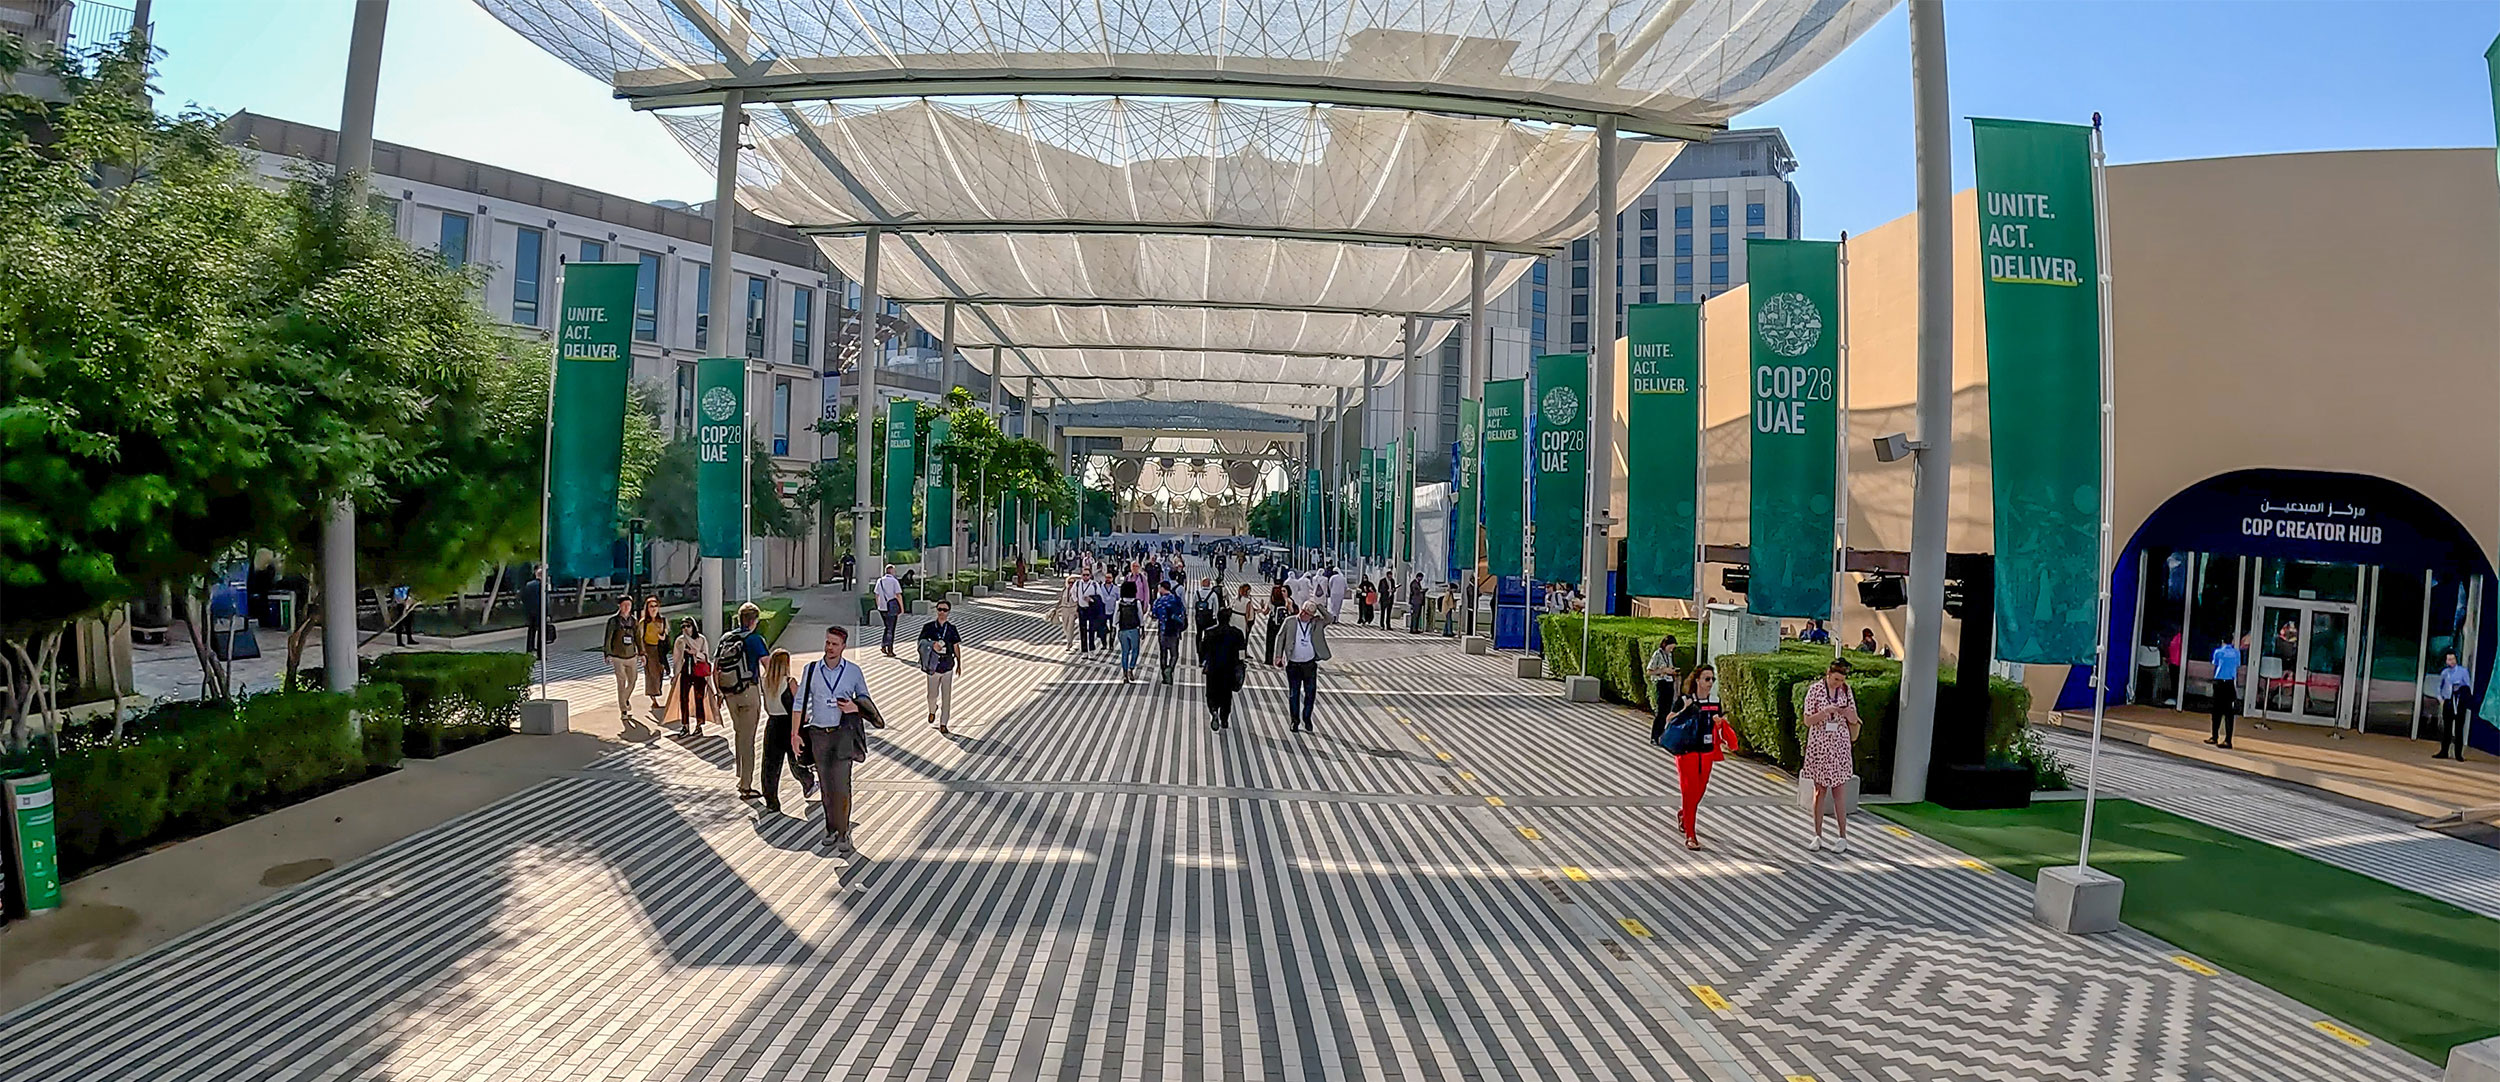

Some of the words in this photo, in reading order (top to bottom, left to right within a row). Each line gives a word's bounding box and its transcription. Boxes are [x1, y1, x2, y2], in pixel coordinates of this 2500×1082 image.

[1987, 191, 2056, 219] UNITE.
[1988, 223, 2034, 249] ACT.
[1990, 254, 2085, 284] DELIVER.
[567, 307, 608, 322] UNITE.
[564, 325, 592, 340] ACT.
[564, 343, 620, 359] DELIVER.
[1633, 343, 1674, 358] UNITE.
[1633, 361, 1660, 375] ACT.
[1633, 378, 1689, 393] DELIVER.
[1756, 365, 1833, 401] COP28
[825, 405, 837, 420] 55
[1487, 406, 1511, 417] UNITE.
[1756, 400, 1806, 435] UAE
[1486, 419, 1502, 429] ACT.
[701, 425, 742, 444] COP28
[1487, 429, 1518, 441] DELIVER.
[1541, 430, 1585, 451] COP28
[701, 444, 728, 462] UAE
[1541, 451, 1568, 472] UAE
[2327, 502, 2366, 519] مركز
[2242, 517, 2273, 536] COP
[2276, 520, 2346, 542] CREATOR
[2349, 525, 2382, 545] HUB
